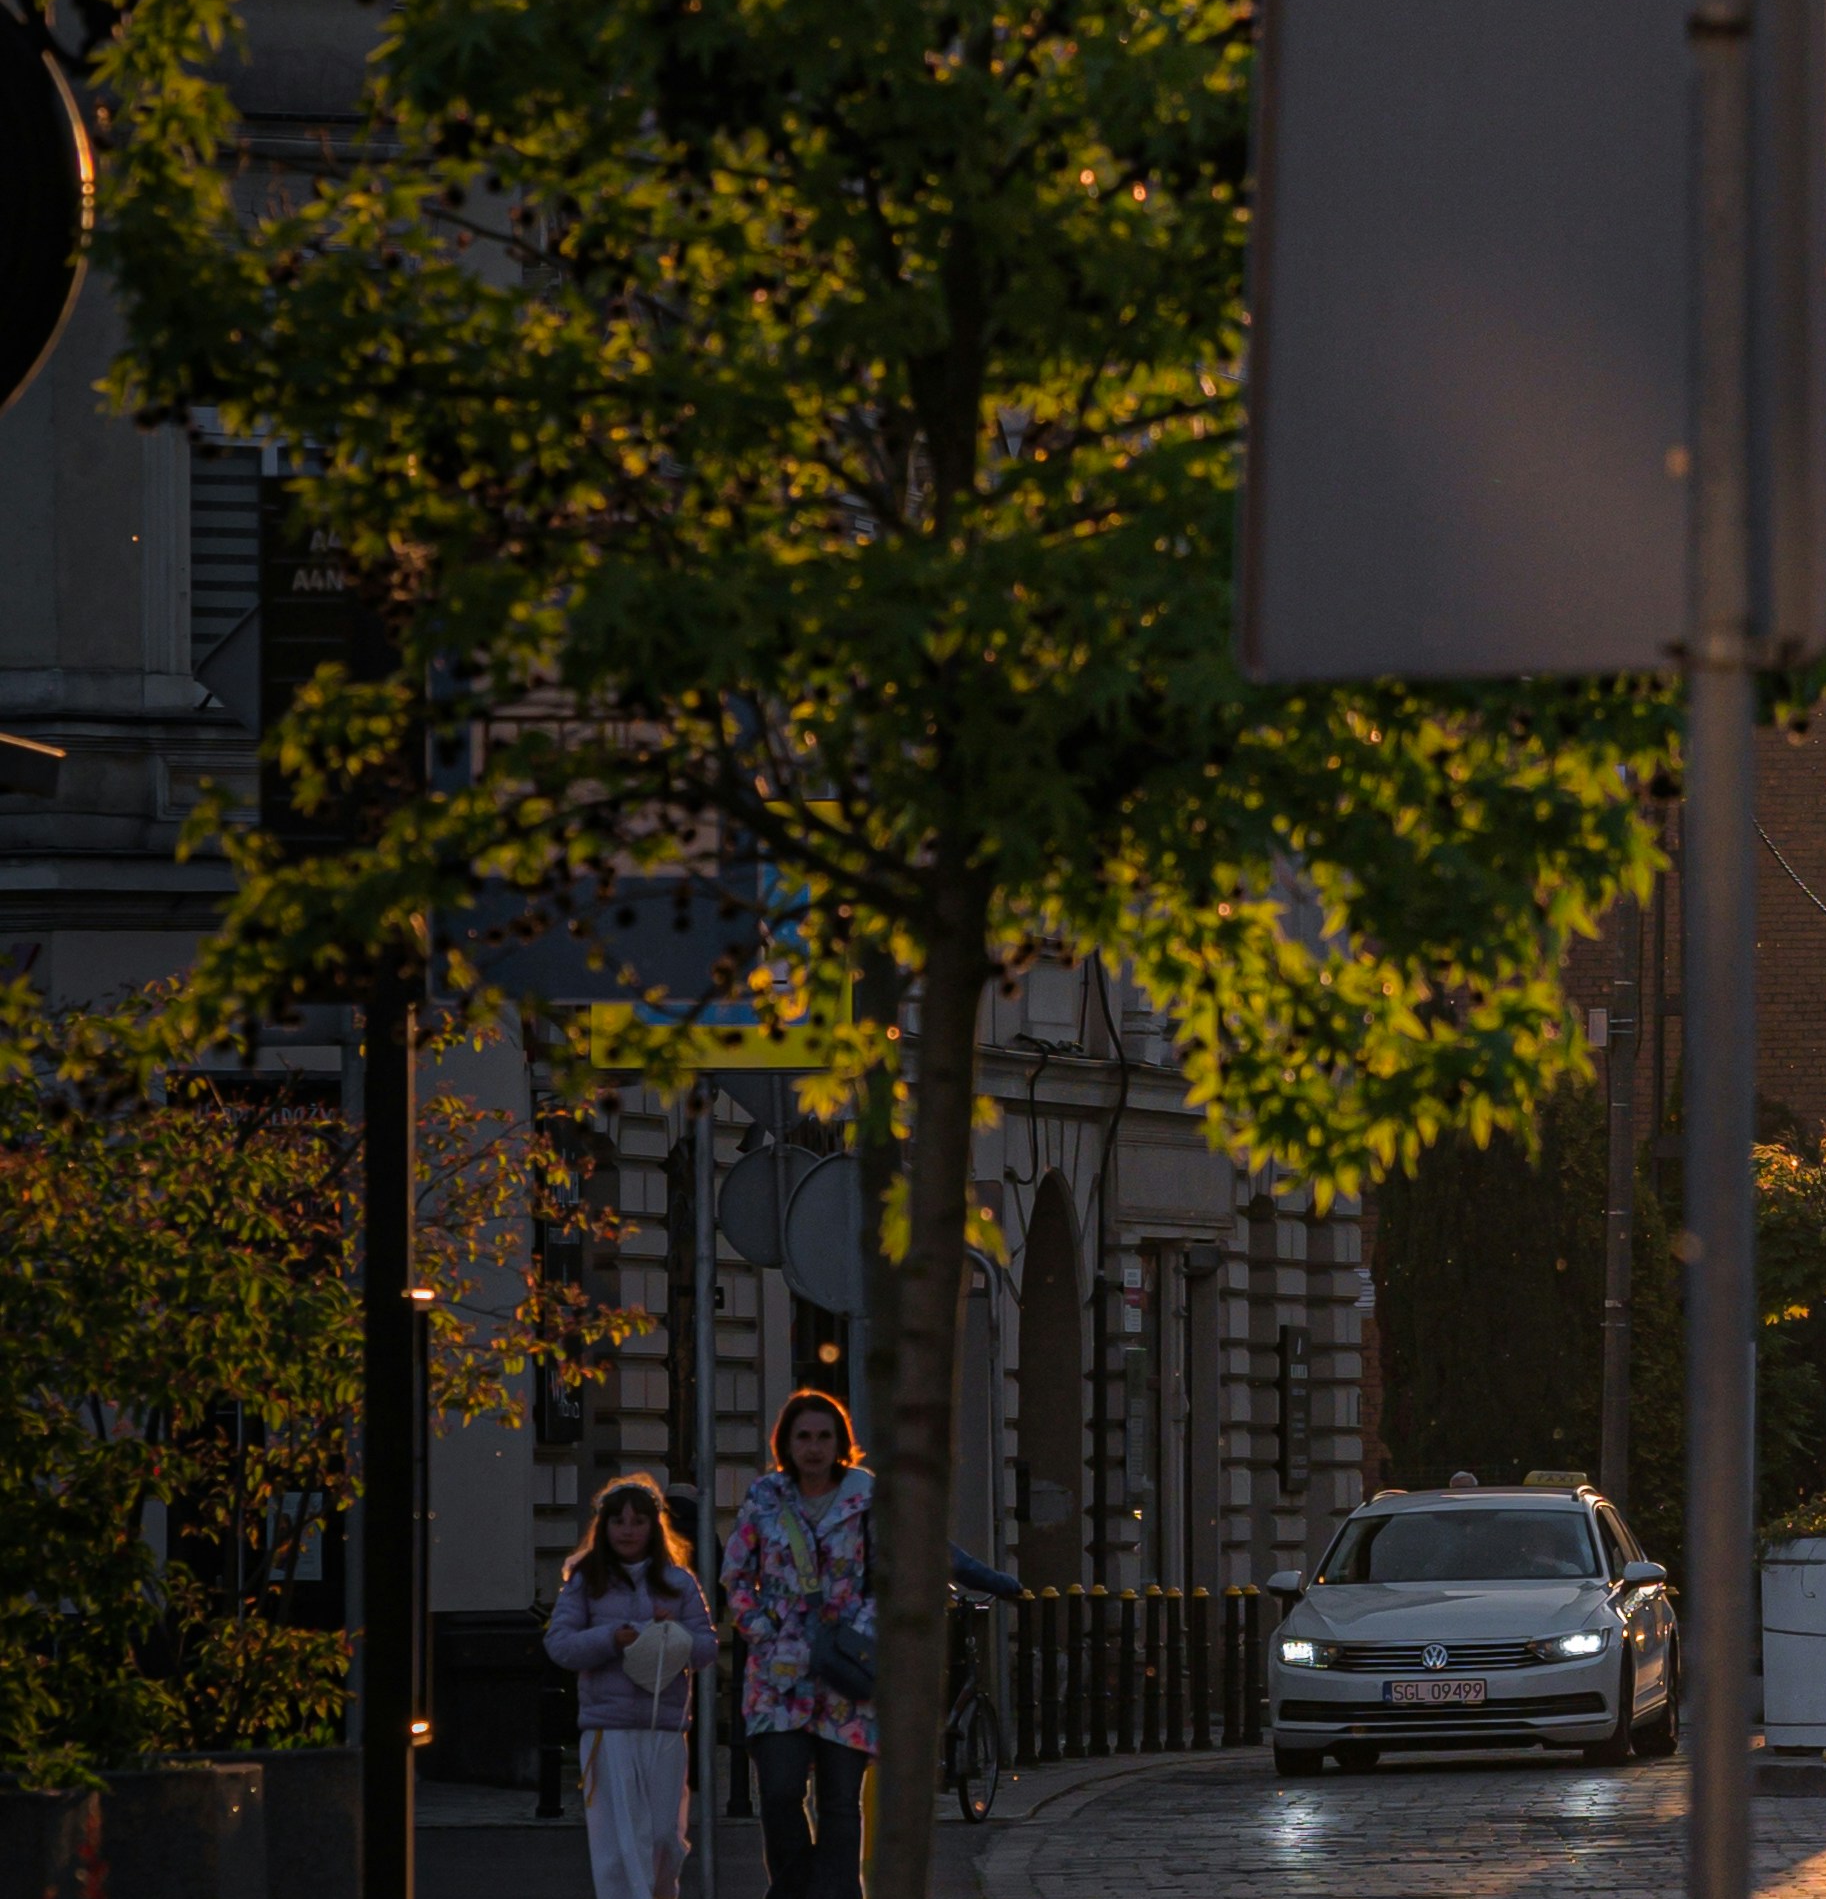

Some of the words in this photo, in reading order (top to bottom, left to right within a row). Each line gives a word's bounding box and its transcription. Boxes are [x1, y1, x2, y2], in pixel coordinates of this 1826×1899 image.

[1535, 1472, 1574, 1482] TAXI
[1393, 1684, 1425, 1701] SGL
[1431, 1683, 1483, 1700] 09499
